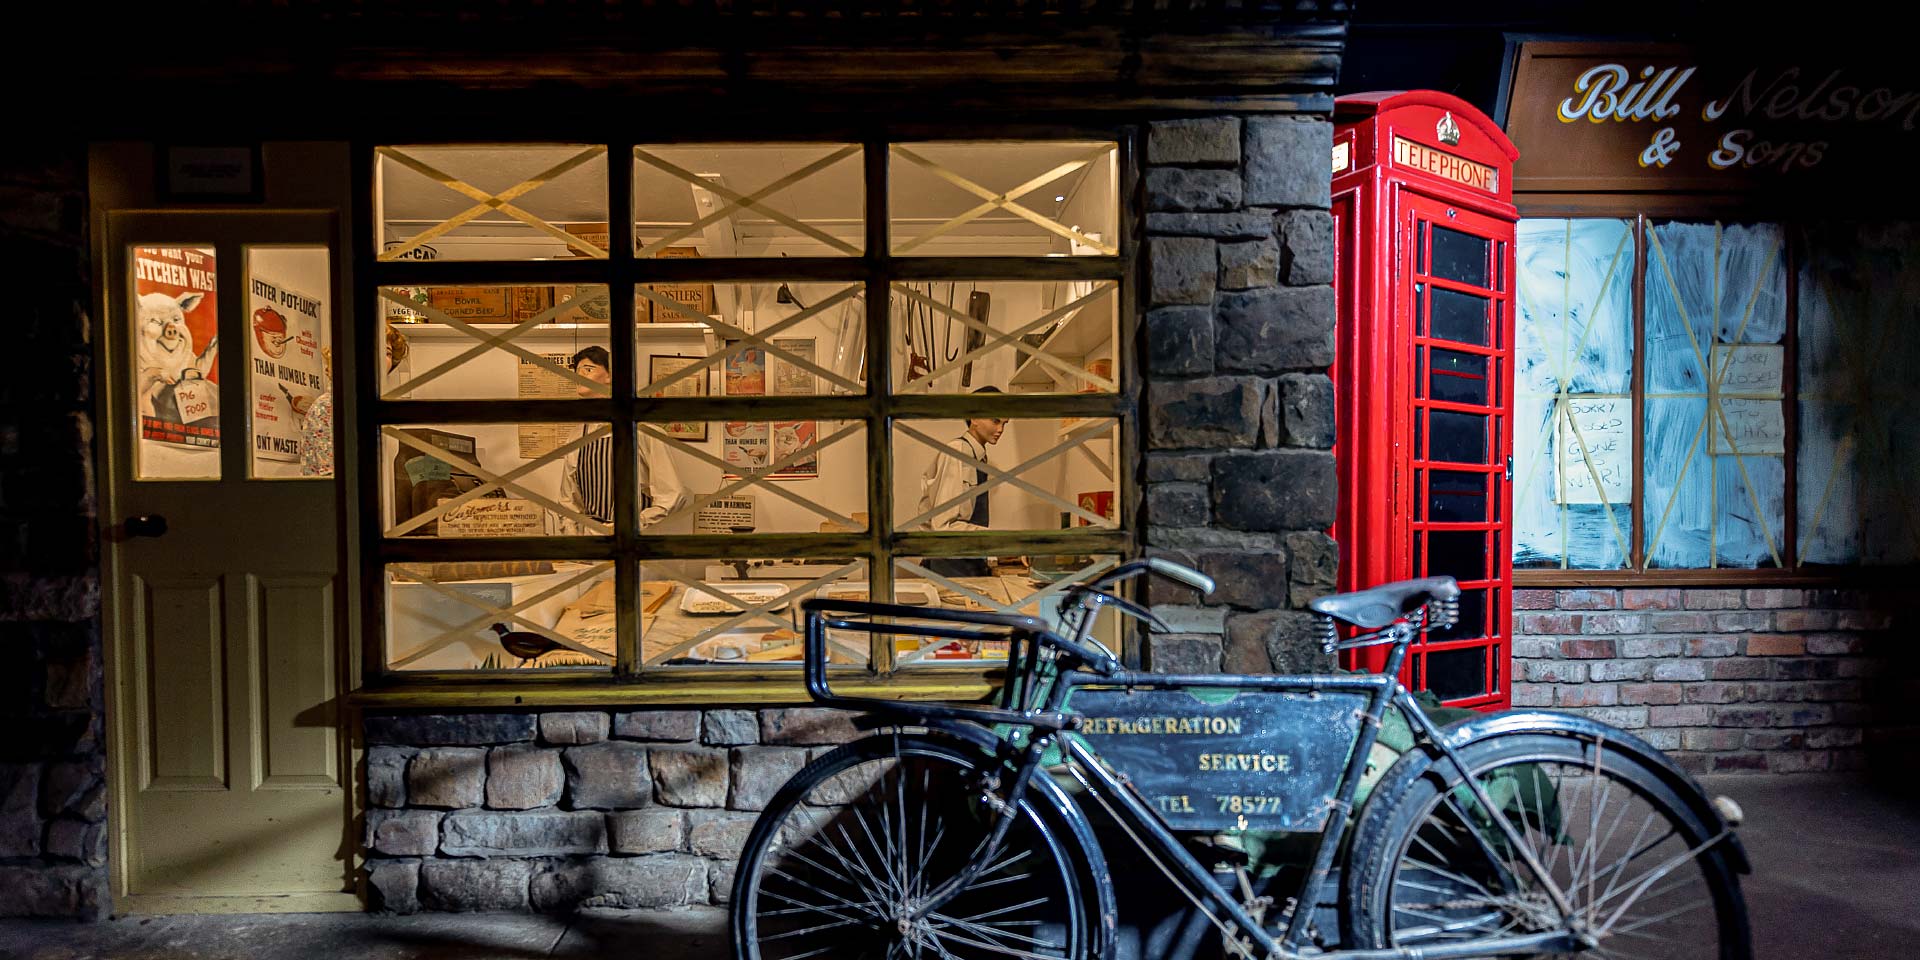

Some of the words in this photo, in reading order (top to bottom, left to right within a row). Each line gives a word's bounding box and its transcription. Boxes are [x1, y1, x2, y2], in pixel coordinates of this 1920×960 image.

[1557, 62, 1698, 123] Bill
[1638, 126, 1681, 168] &
[1706, 127, 1830, 177] Sons
[1396, 140, 1492, 190] TELEPHONE
[184, 251, 204, 265] your
[189, 267, 216, 292] WAS
[280, 288, 318, 319] POT-LUCK
[254, 357, 276, 378] THAN
[278, 365, 307, 387] HUMBLE
[309, 374, 321, 390] PIE
[179, 390, 195, 402] PIG
[184, 401, 208, 415] FOOD
[272, 435, 298, 455] WASTE
[725, 437, 737, 446] THAN
[739, 437, 758, 446] HUMBLE
[759, 437, 768, 446] PIE
[1081, 716, 1242, 736] REFRIGERATION
[1199, 753, 1291, 773] SERVICE
[1158, 795, 1196, 814] TEL
[1216, 795, 1282, 815] 78577
